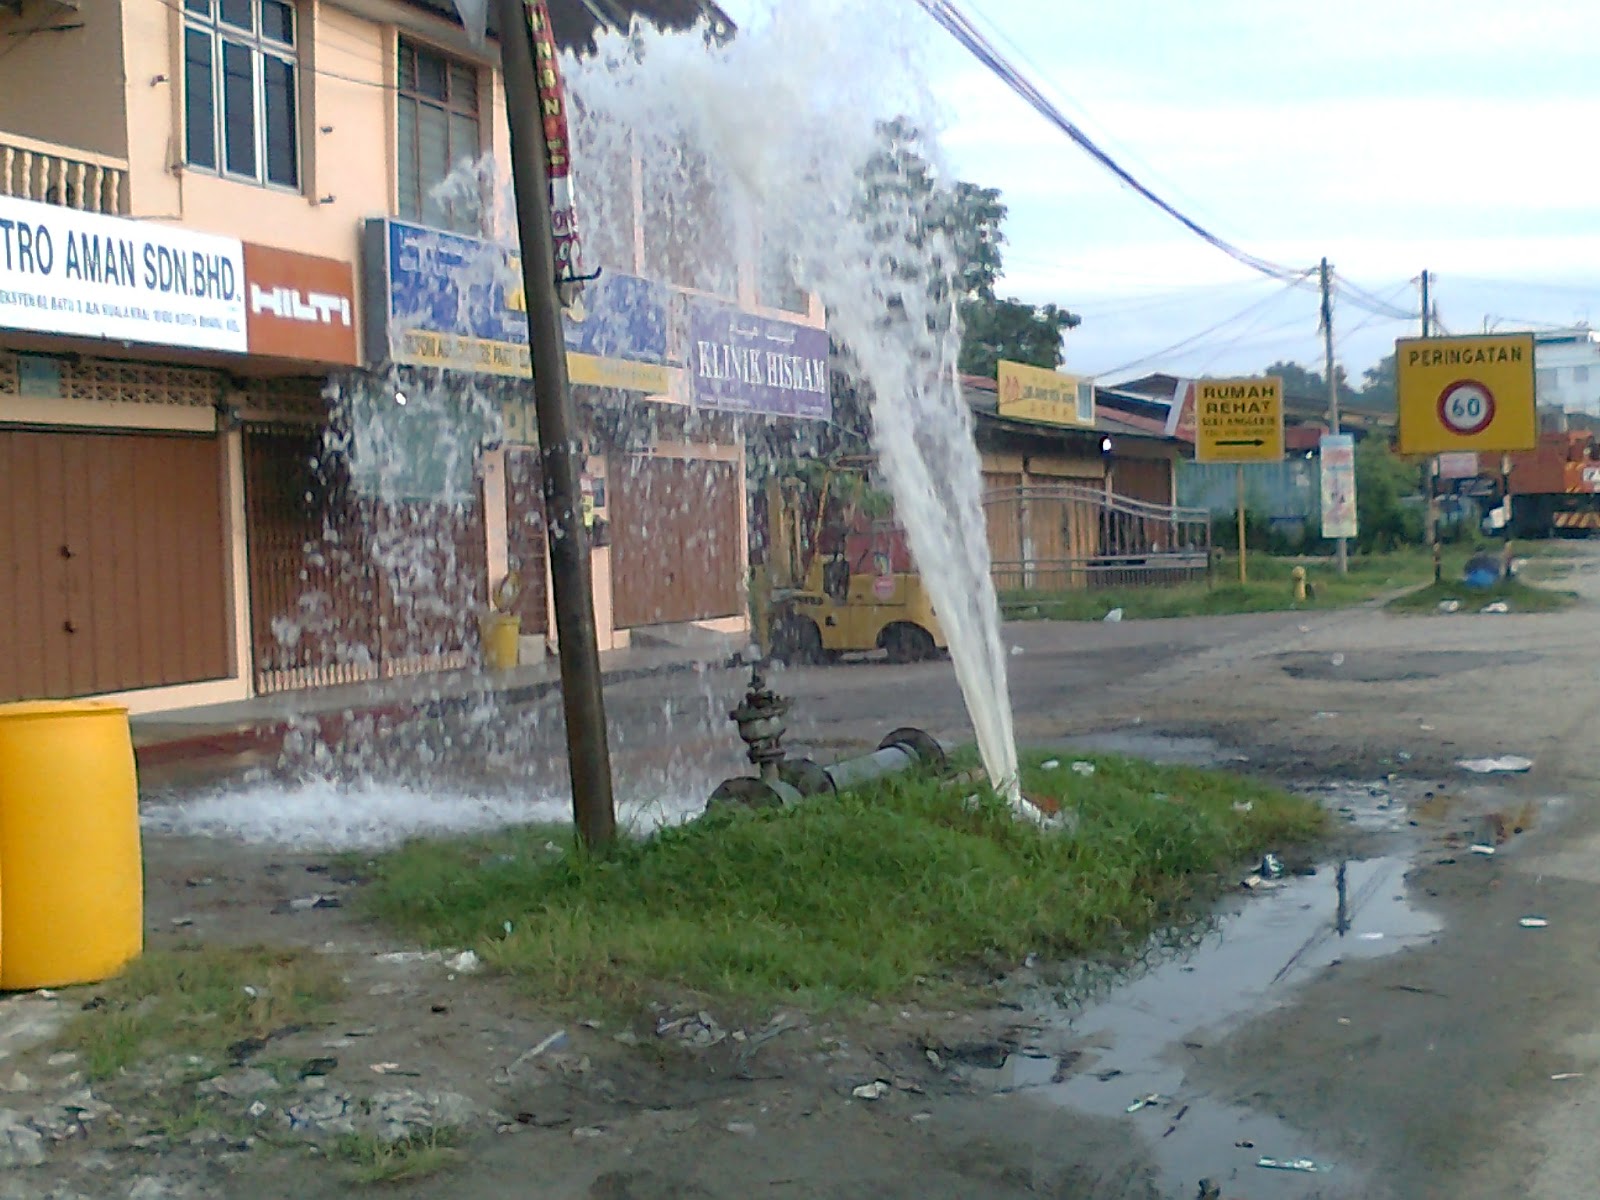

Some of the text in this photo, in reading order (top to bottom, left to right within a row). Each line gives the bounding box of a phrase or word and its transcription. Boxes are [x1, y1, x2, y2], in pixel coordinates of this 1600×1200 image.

[66, 229, 137, 288] AMAN
[251, 283, 351, 327] HILTI
[698, 341, 763, 384] KLINIK
[1408, 347, 1522, 367] PERINGATAN
[1203, 385, 1274, 399] RUMAH
[1206, 401, 1270, 415] REHAT
[1452, 398, 1480, 417] 60
